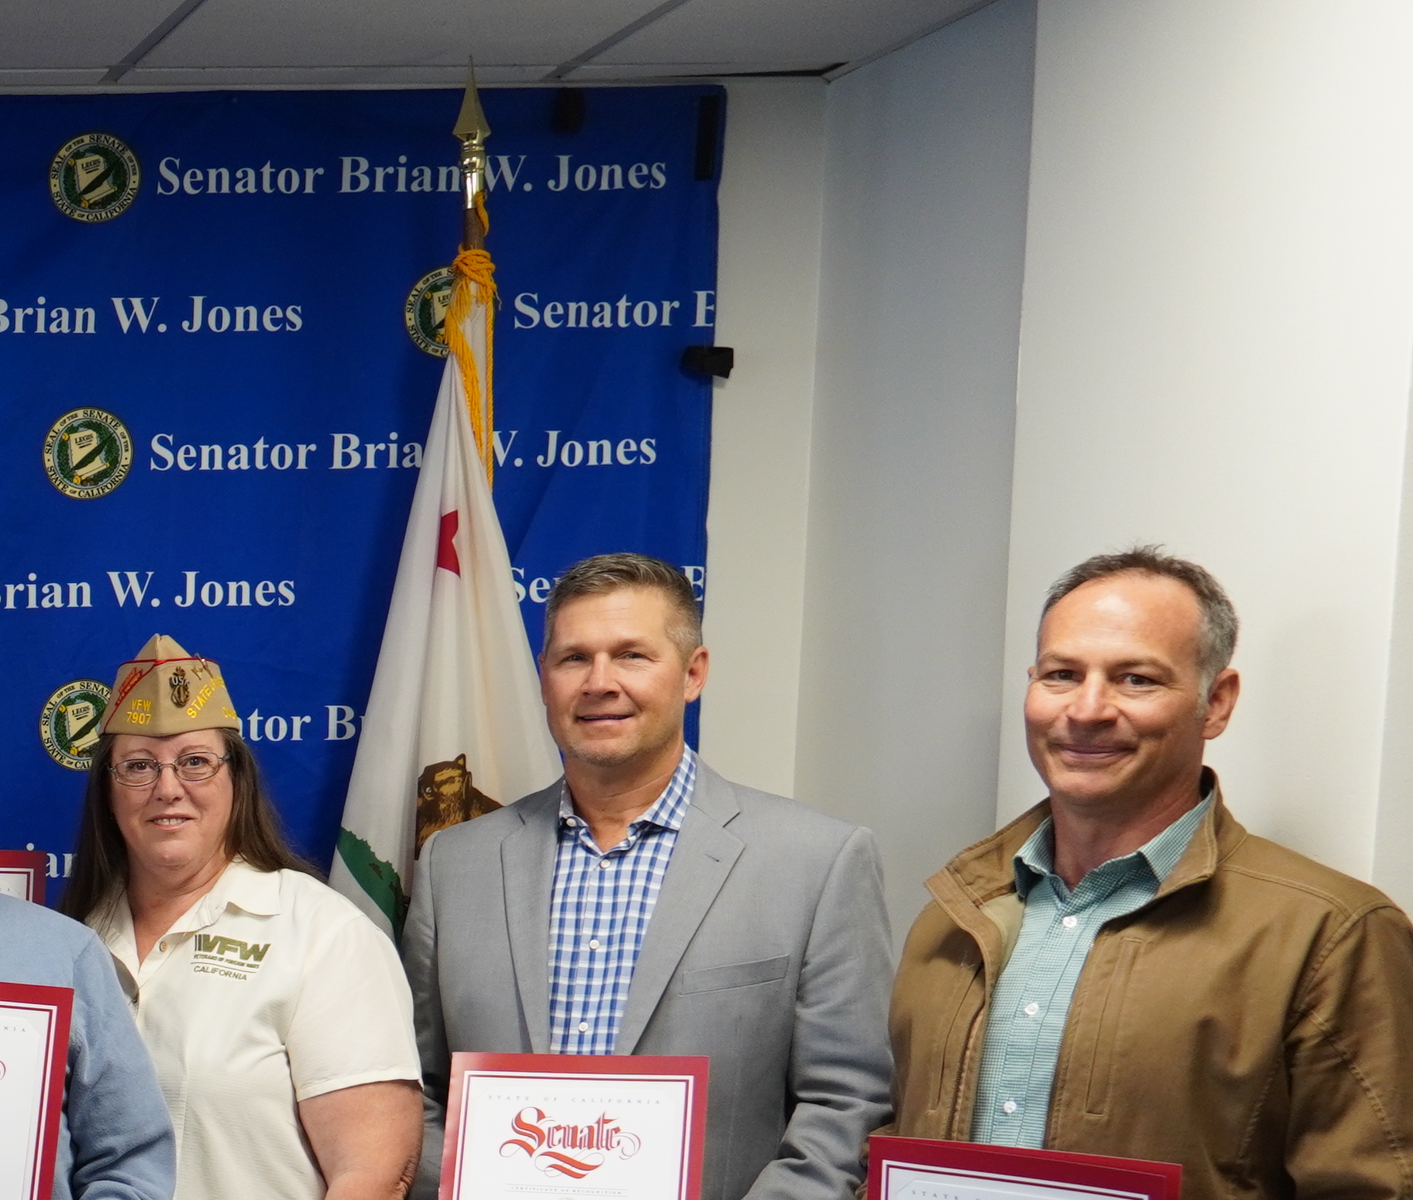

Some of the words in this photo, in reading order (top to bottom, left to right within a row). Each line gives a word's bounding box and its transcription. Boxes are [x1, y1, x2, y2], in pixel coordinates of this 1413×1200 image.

[157, 157, 324, 195] Senator
[548, 156, 665, 191] Jones
[112, 298, 166, 333] W.
[182, 296, 302, 332] Jones
[515, 293, 679, 328] Senator
[151, 434, 316, 470] Senator
[331, 432, 423, 469] Bria
[537, 431, 656, 467] Jones
[107, 572, 160, 607] W.
[175, 572, 294, 607] Jones
[127, 712, 151, 725] 7907
[131, 699, 151, 710] VFW
[187, 684, 212, 718] STATE
[194, 934, 271, 962] VFW
[194, 966, 247, 980] CALIFORNIA
[499, 1107, 641, 1168] Senate
